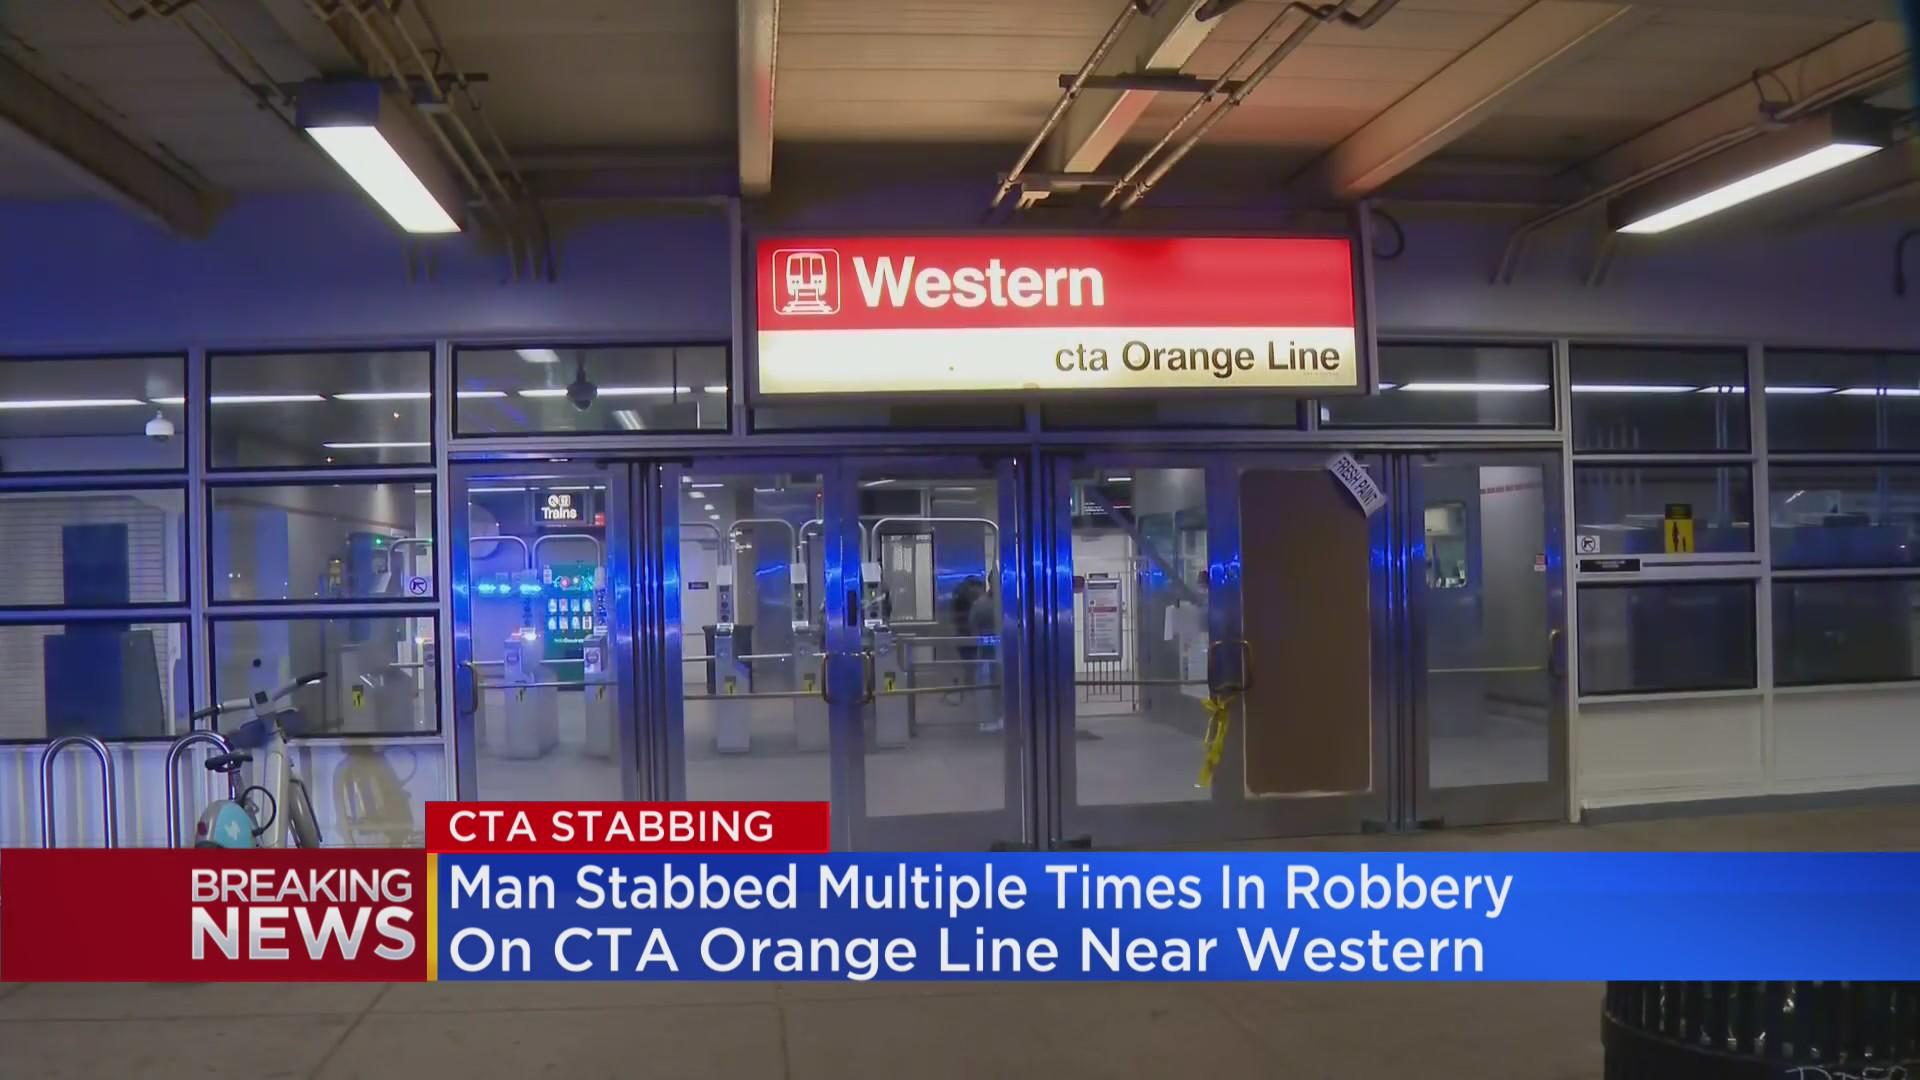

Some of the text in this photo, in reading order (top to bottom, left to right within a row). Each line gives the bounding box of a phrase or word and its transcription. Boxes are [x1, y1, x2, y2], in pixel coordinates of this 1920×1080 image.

[853, 256, 1105, 308] Western
[1055, 341, 1340, 379] cta Orange Line
[1334, 456, 1378, 506] FRESH PAINT
